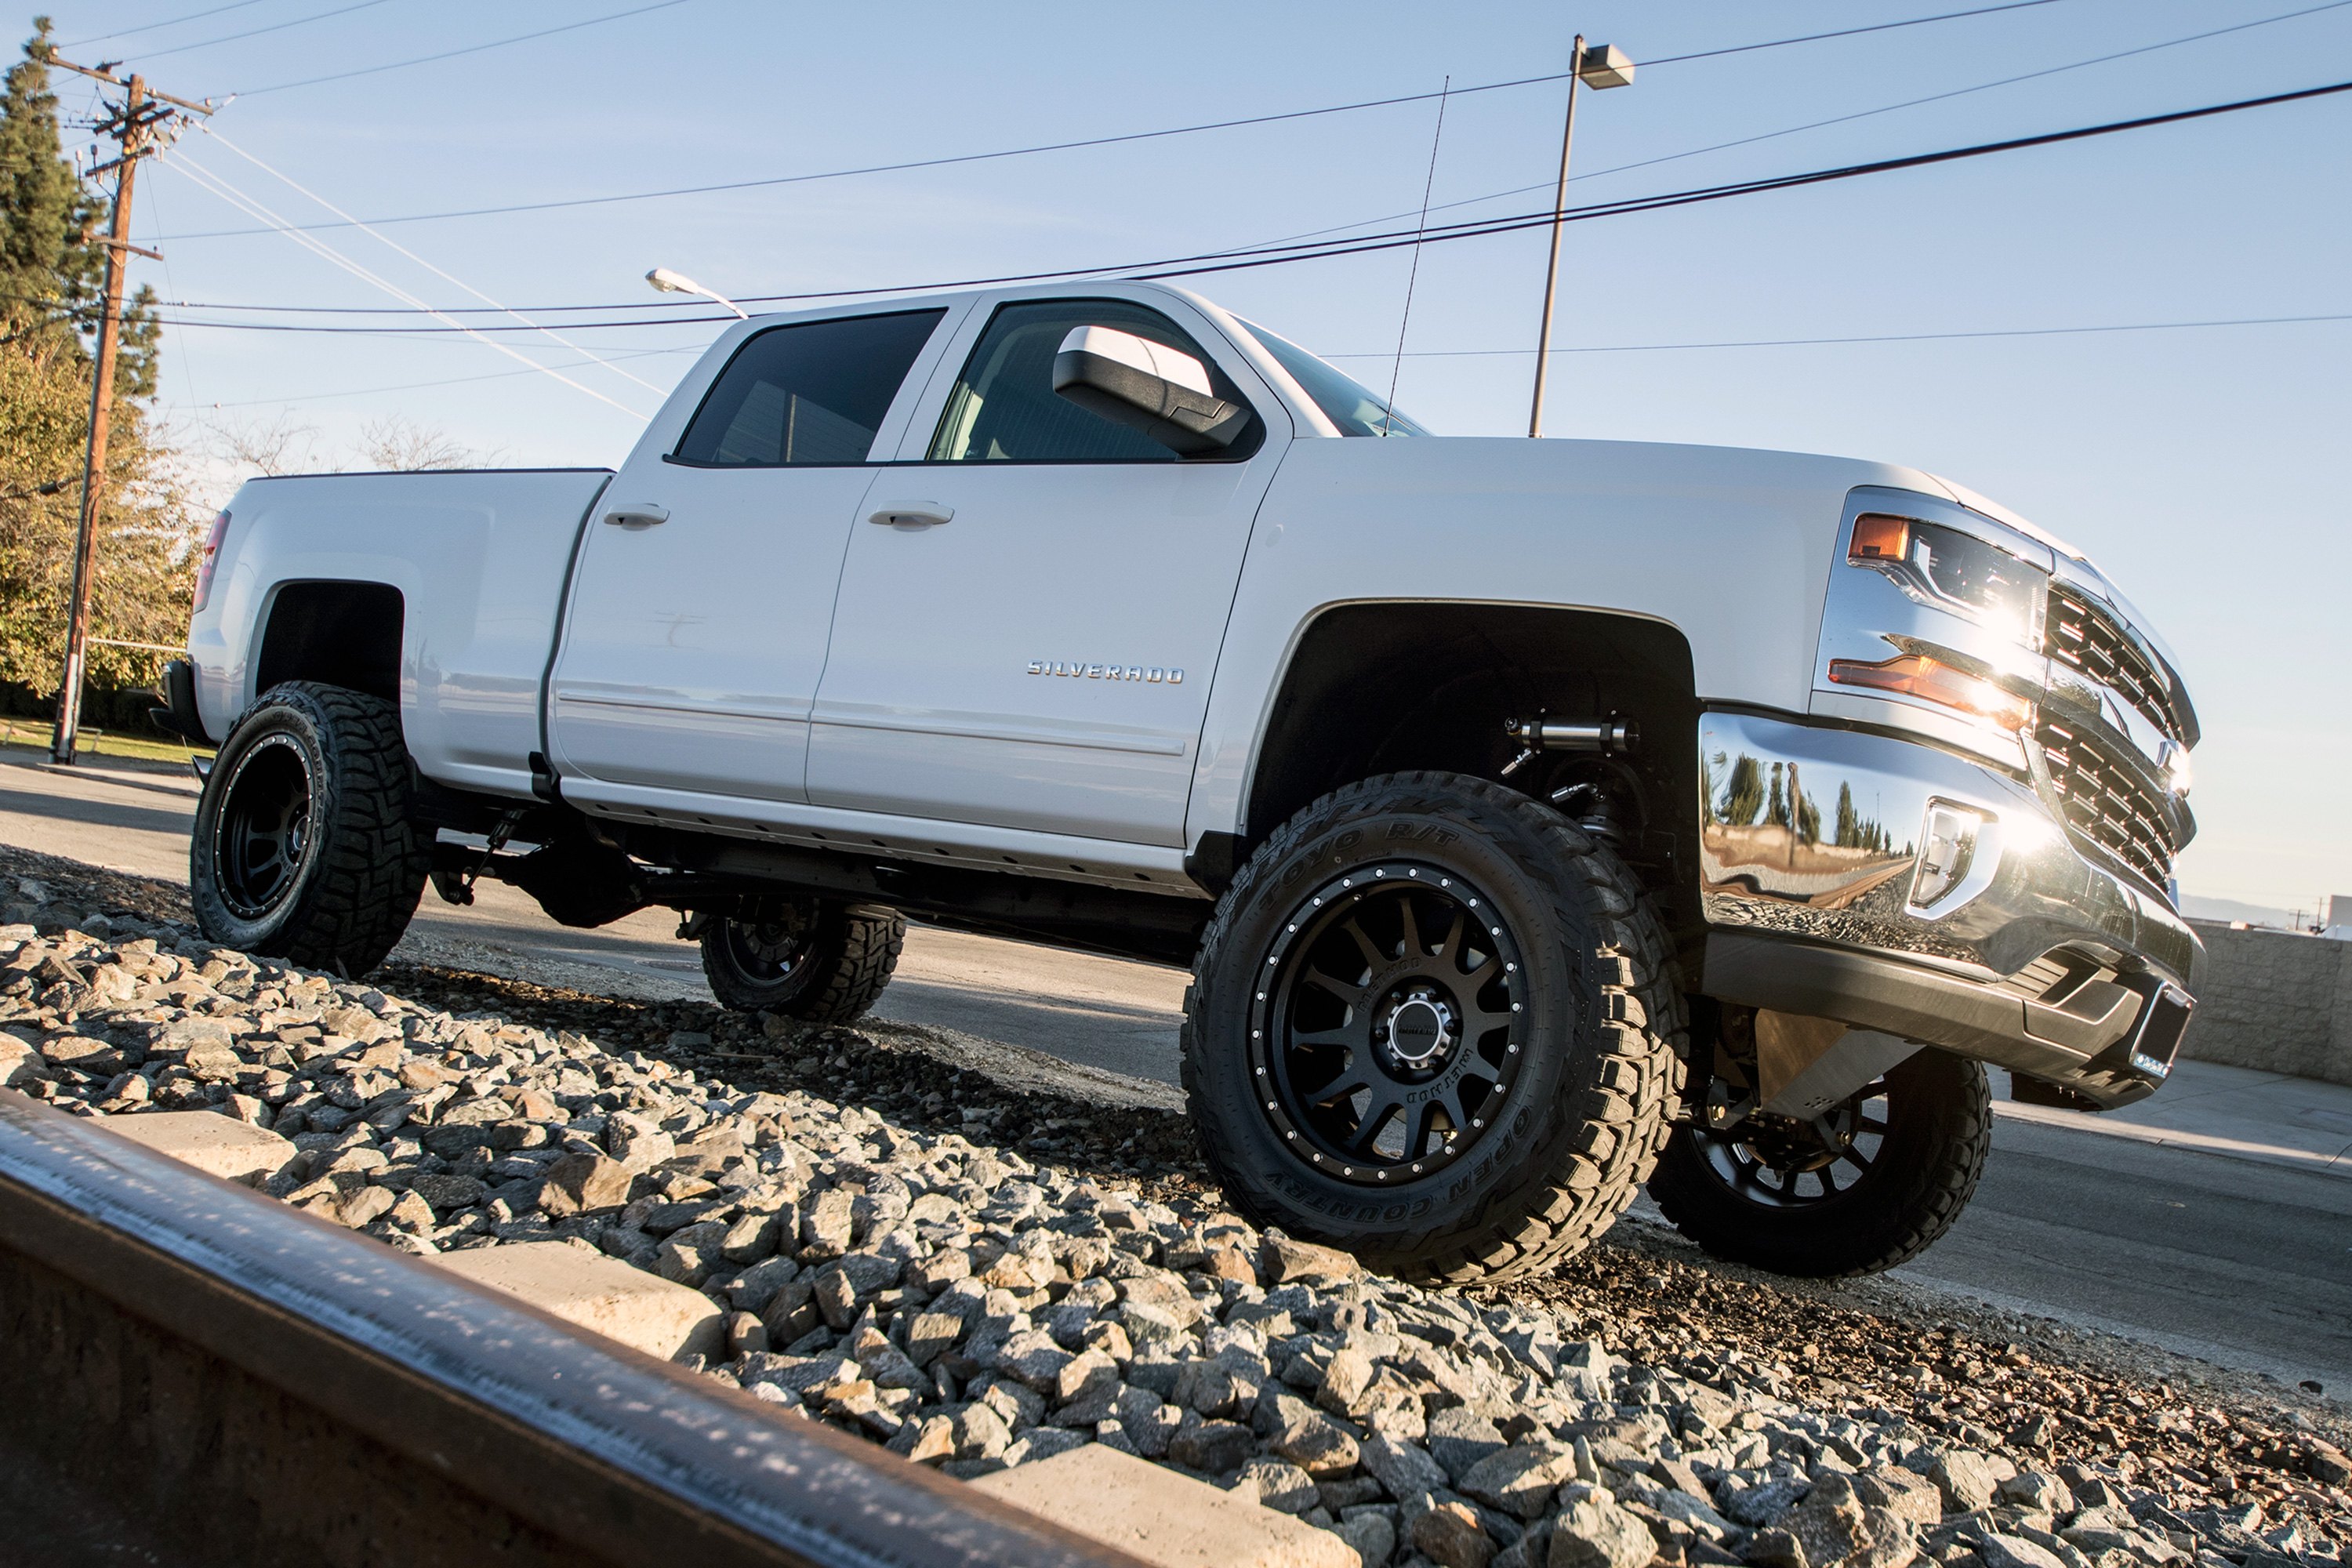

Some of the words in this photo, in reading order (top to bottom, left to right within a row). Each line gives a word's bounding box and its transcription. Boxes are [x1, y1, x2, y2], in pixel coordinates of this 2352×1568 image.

[1027, 659, 1185, 684] SILVERADO
[1258, 827, 1364, 911] TOYO
[1385, 820, 1461, 847] R/T
[201, 891, 236, 940] TOYO
[1356, 956, 1422, 1014] METHOD
[1406, 1047, 1475, 1105] METHOD
[1448, 1105, 1532, 1204] OPEN
[1261, 1172, 1434, 1224] COUNTRY
